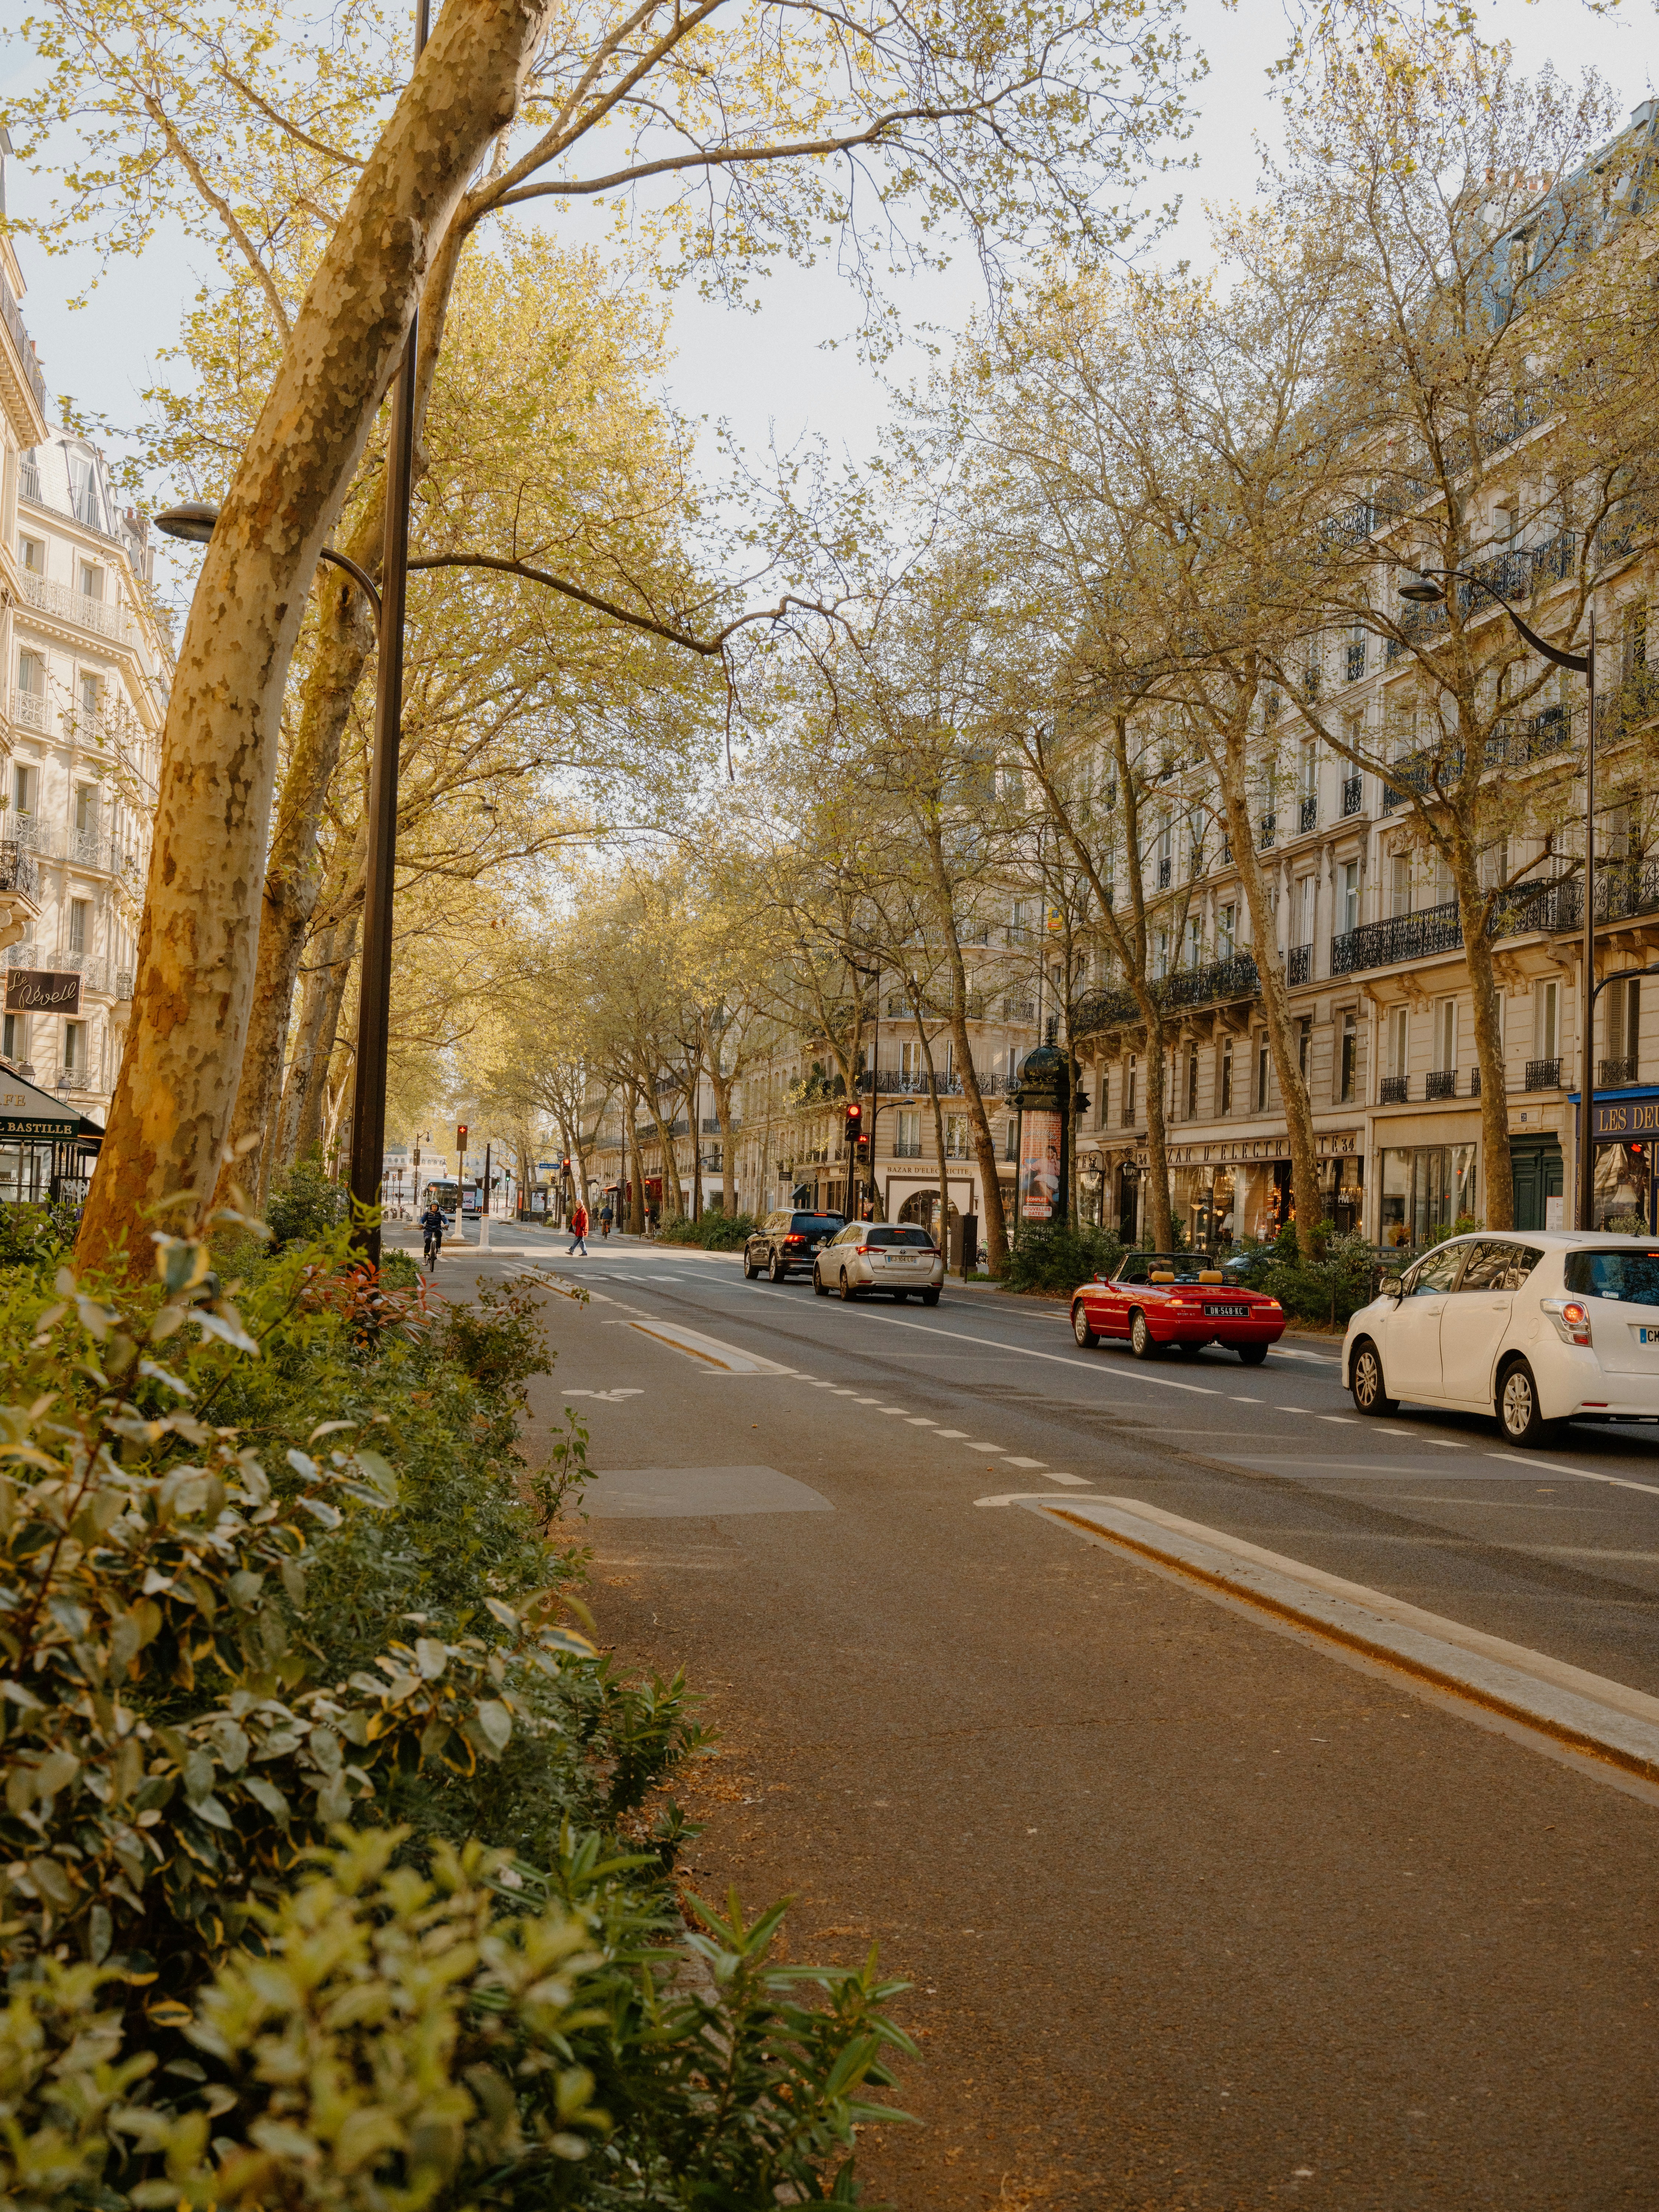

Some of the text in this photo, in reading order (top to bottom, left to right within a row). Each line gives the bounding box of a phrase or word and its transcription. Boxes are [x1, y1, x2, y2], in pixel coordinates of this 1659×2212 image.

[8, 972, 28, 991] Le
[0, 1094, 25, 1106] FE
[1599, 1107, 1627, 1131] LES
[7, 1122, 72, 1134] BASTILLE
[1041, 1129, 1057, 1140] Mayo
[1138, 1154, 1147, 1164] 34
[1168, 1147, 1191, 1163] ZAR
[1342, 1138, 1354, 1152] 34
[1210, 1307, 1243, 1315] DN-548-KC
[1648, 1331, 1659, 1342] CM
